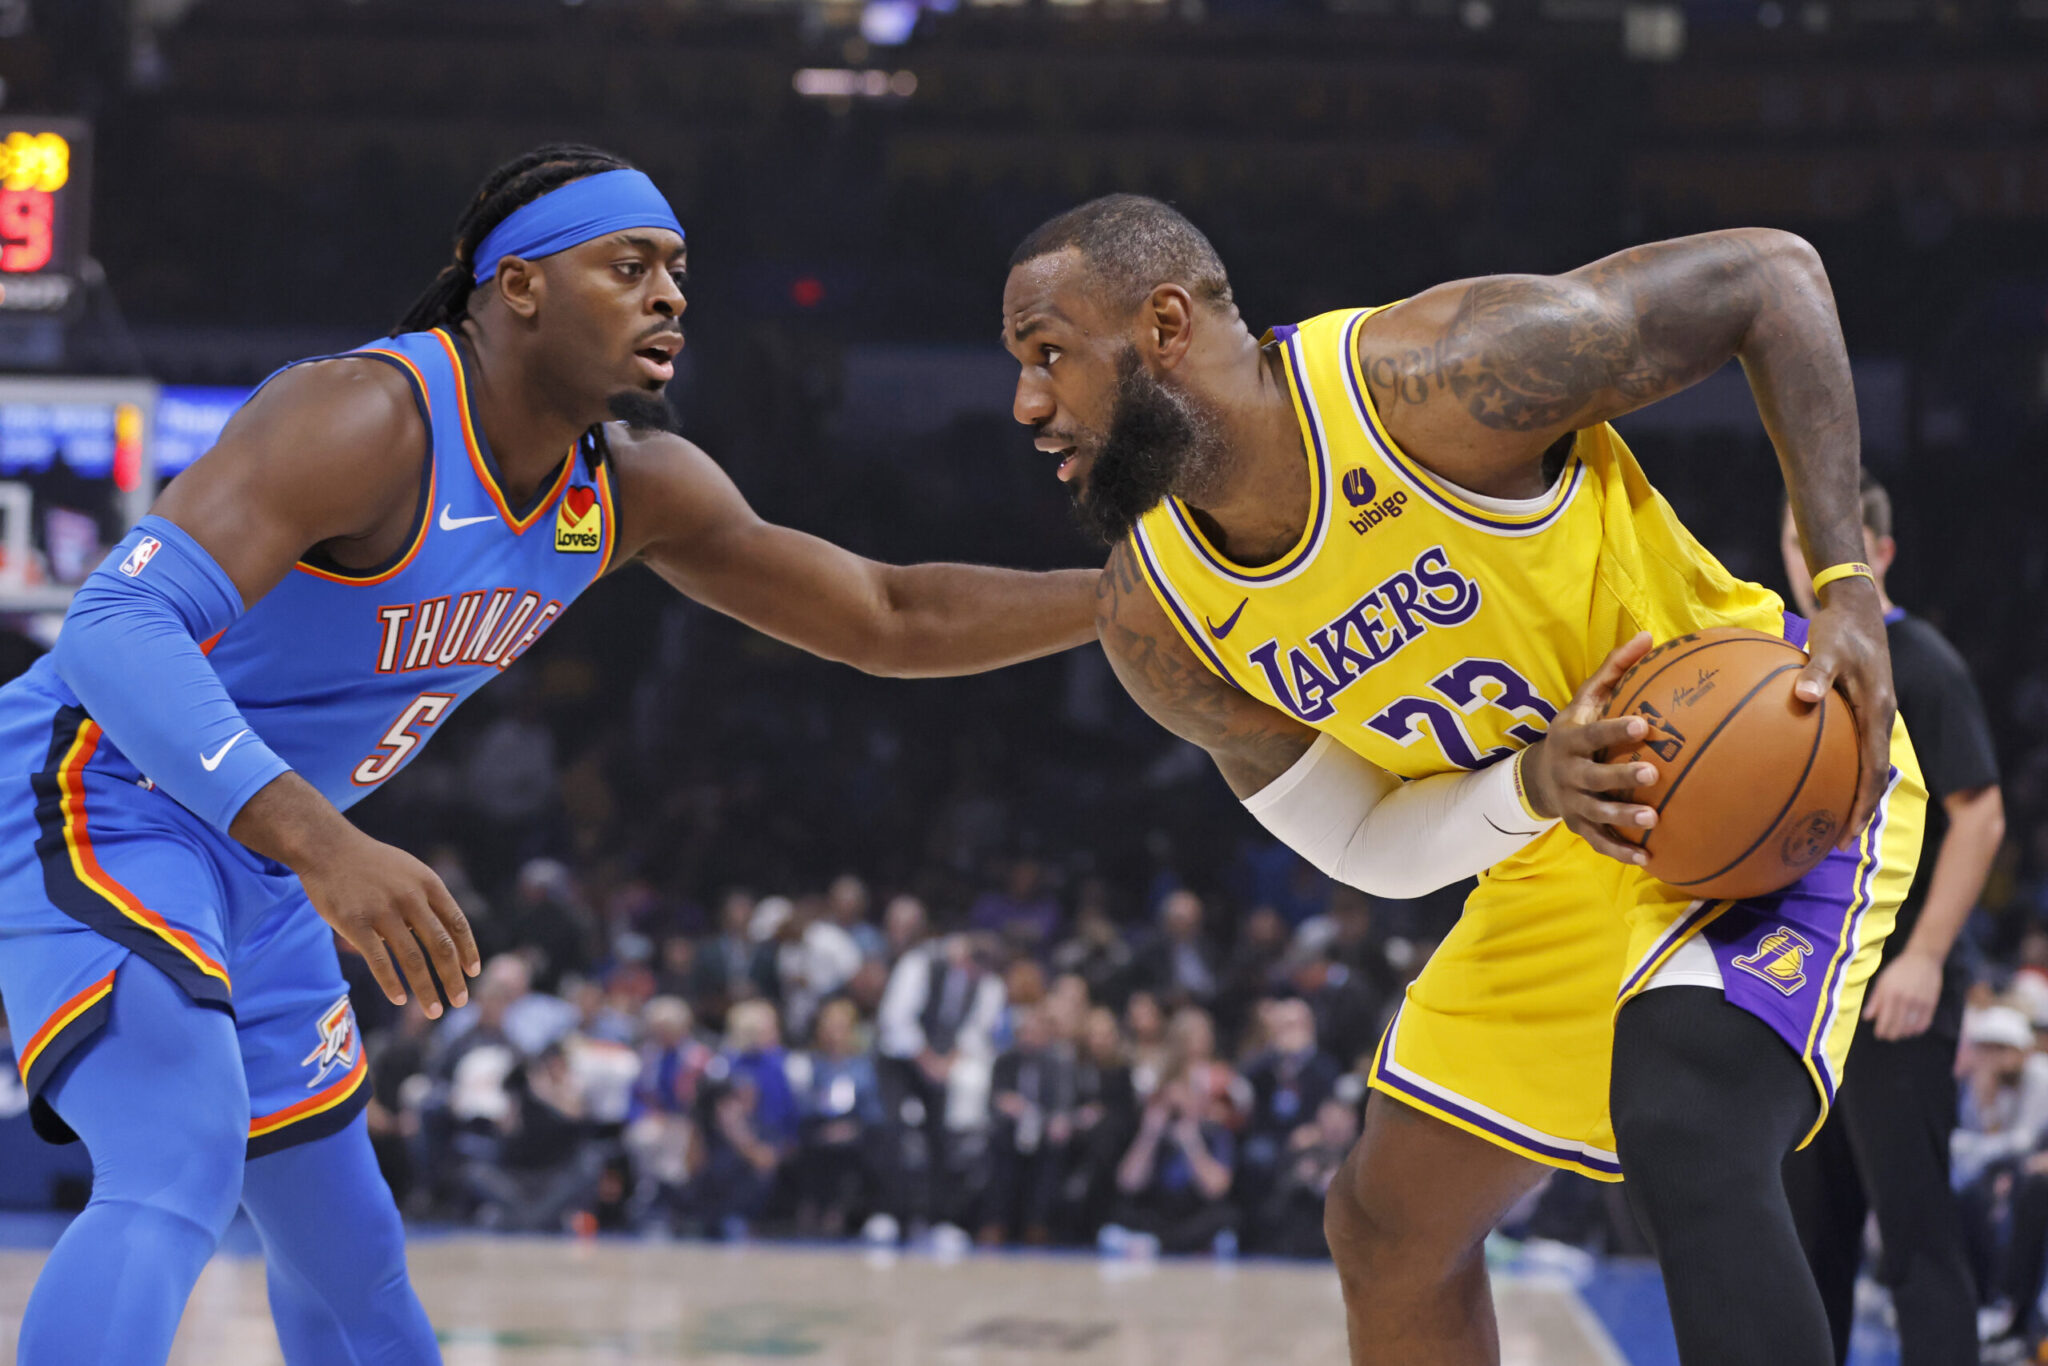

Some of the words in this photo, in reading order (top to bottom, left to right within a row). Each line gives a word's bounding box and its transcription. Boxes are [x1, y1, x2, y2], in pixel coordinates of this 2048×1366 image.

[1349, 491, 1408, 535] bibigo
[375, 588, 566, 674] THUNDE
[1247, 544, 1482, 723] LAKERS
[350, 692, 458, 787] 5
[1361, 657, 1560, 770] 23
